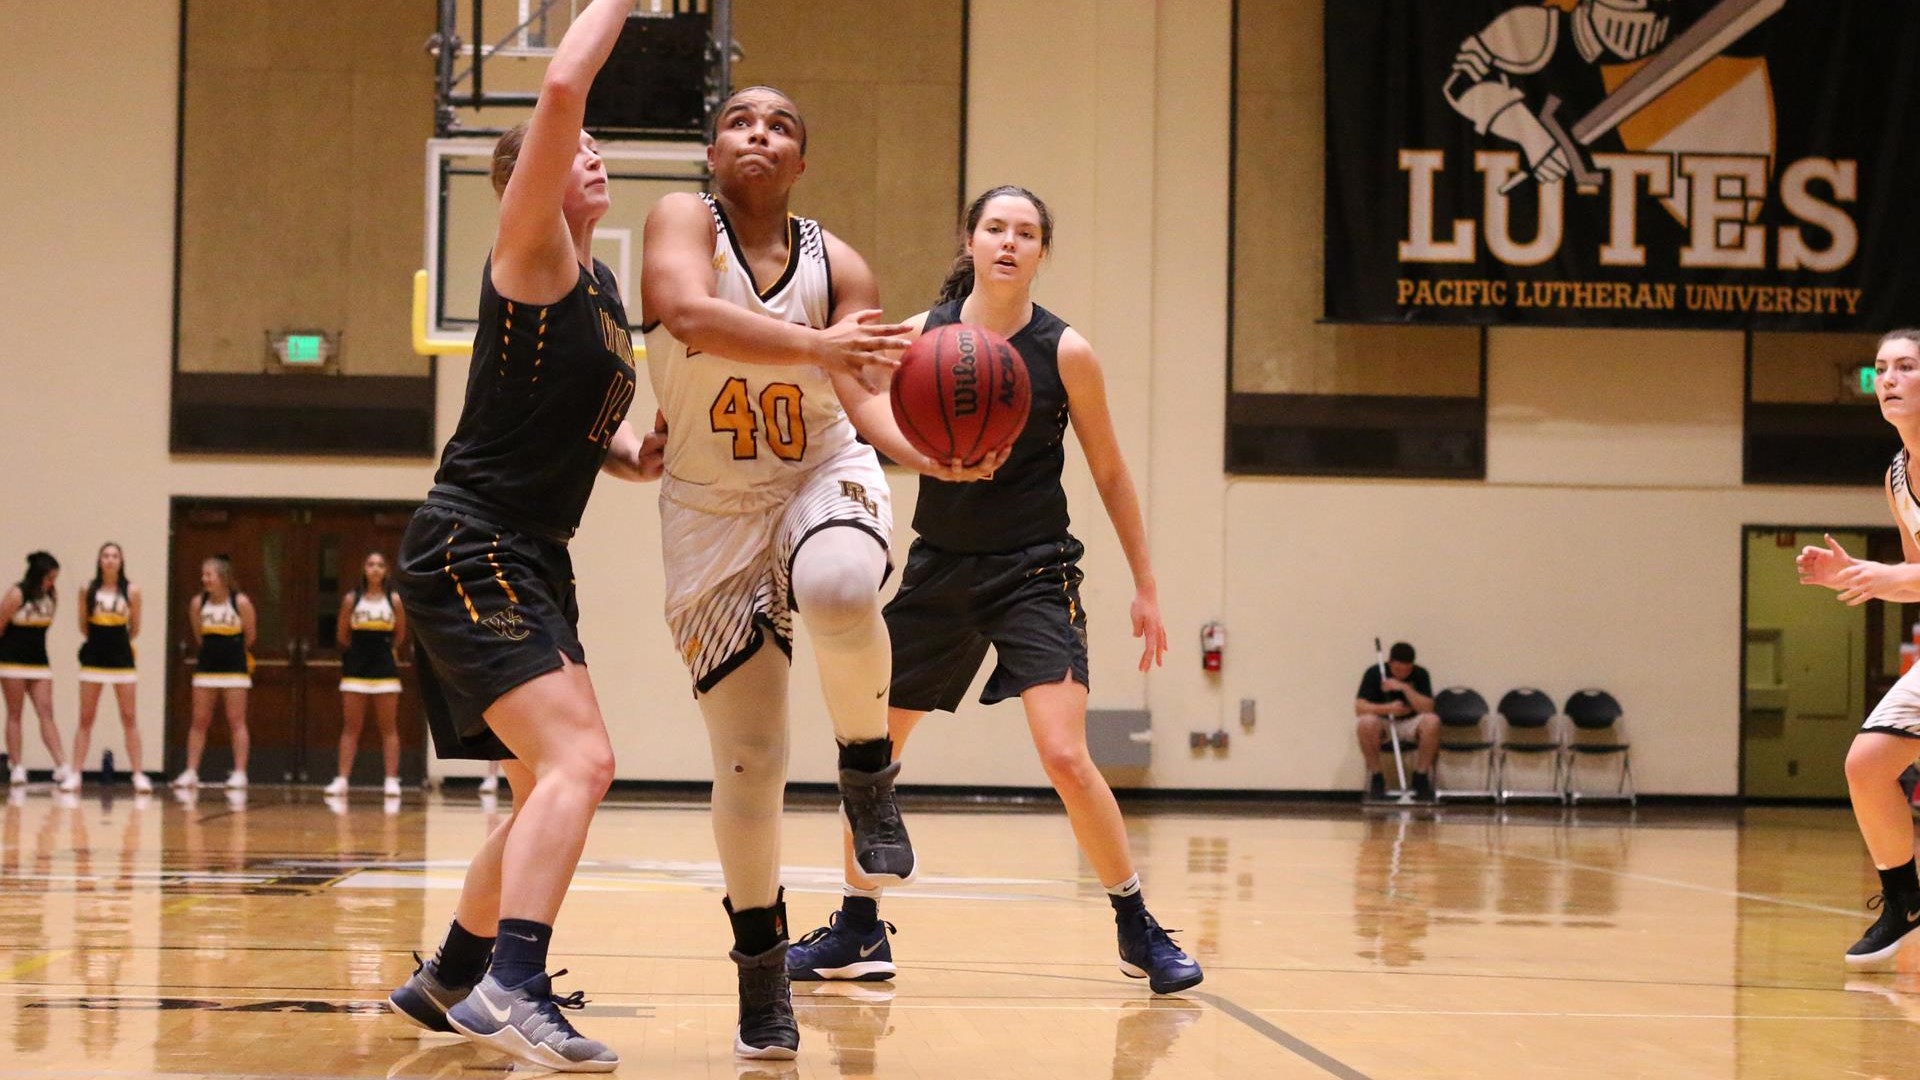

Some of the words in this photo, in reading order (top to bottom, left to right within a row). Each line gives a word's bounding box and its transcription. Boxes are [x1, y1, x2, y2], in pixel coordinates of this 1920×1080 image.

[1399, 149, 1858, 273] LUTES
[1397, 279, 1507, 306] PACIFIC
[1516, 281, 1676, 310] LUTHERAN
[1685, 284, 1862, 314] UNIVERSITY
[952, 331, 978, 418] Wilson
[709, 376, 807, 462] 40
